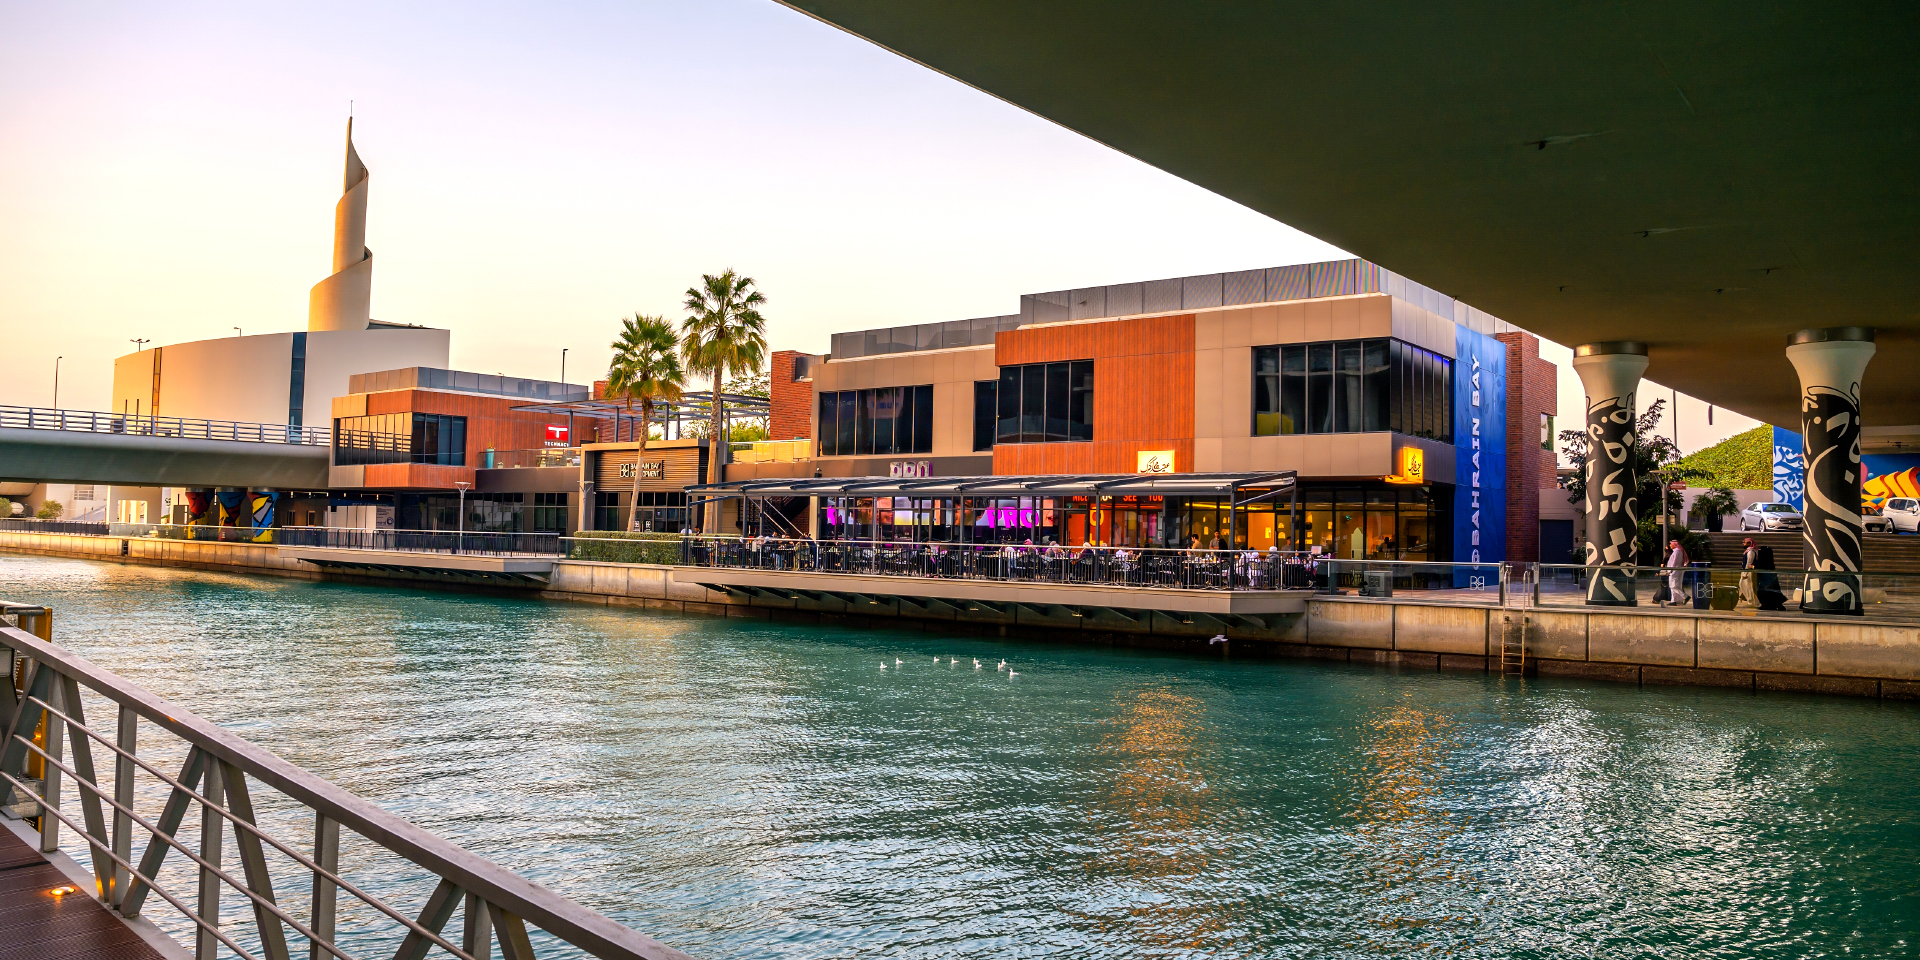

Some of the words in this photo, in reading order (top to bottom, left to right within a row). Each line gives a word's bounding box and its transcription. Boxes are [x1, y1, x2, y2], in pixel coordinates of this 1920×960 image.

[1471, 353, 1480, 407] BAY
[548, 426, 568, 438] T
[987, 506, 1039, 528] PRO
